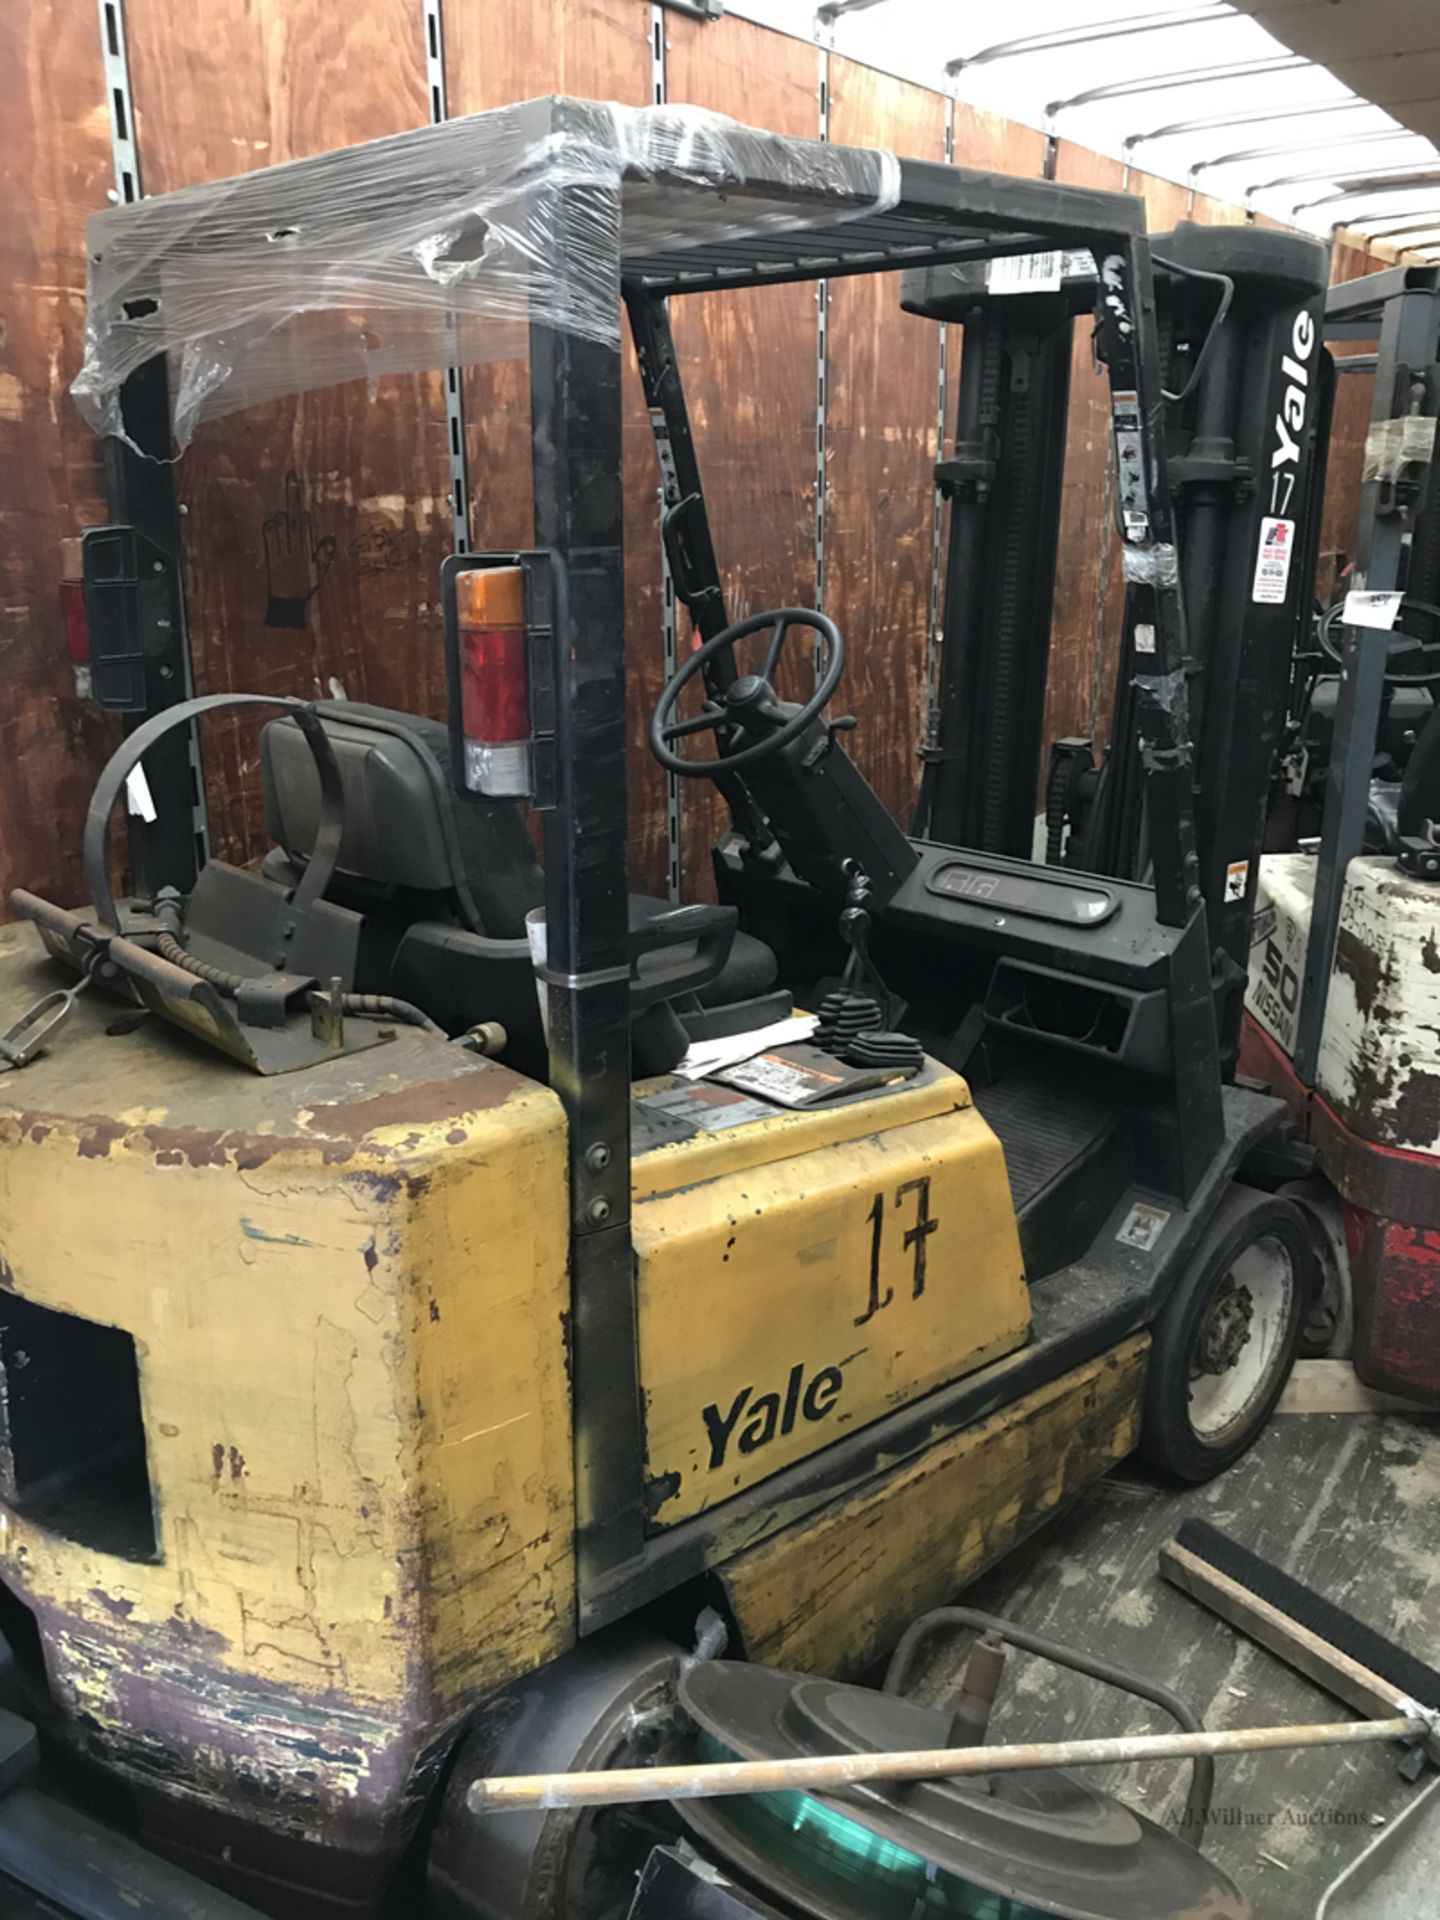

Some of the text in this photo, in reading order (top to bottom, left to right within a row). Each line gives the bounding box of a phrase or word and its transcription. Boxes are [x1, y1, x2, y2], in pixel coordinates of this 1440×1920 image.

[1271, 310, 1315, 469] Yale
[1270, 471, 1295, 516] 17
[1252, 979, 1293, 1047] NISSAN
[1262, 937, 1299, 1015] 50
[853, 1175, 939, 1327] 17
[702, 1362, 843, 1471] Yale
